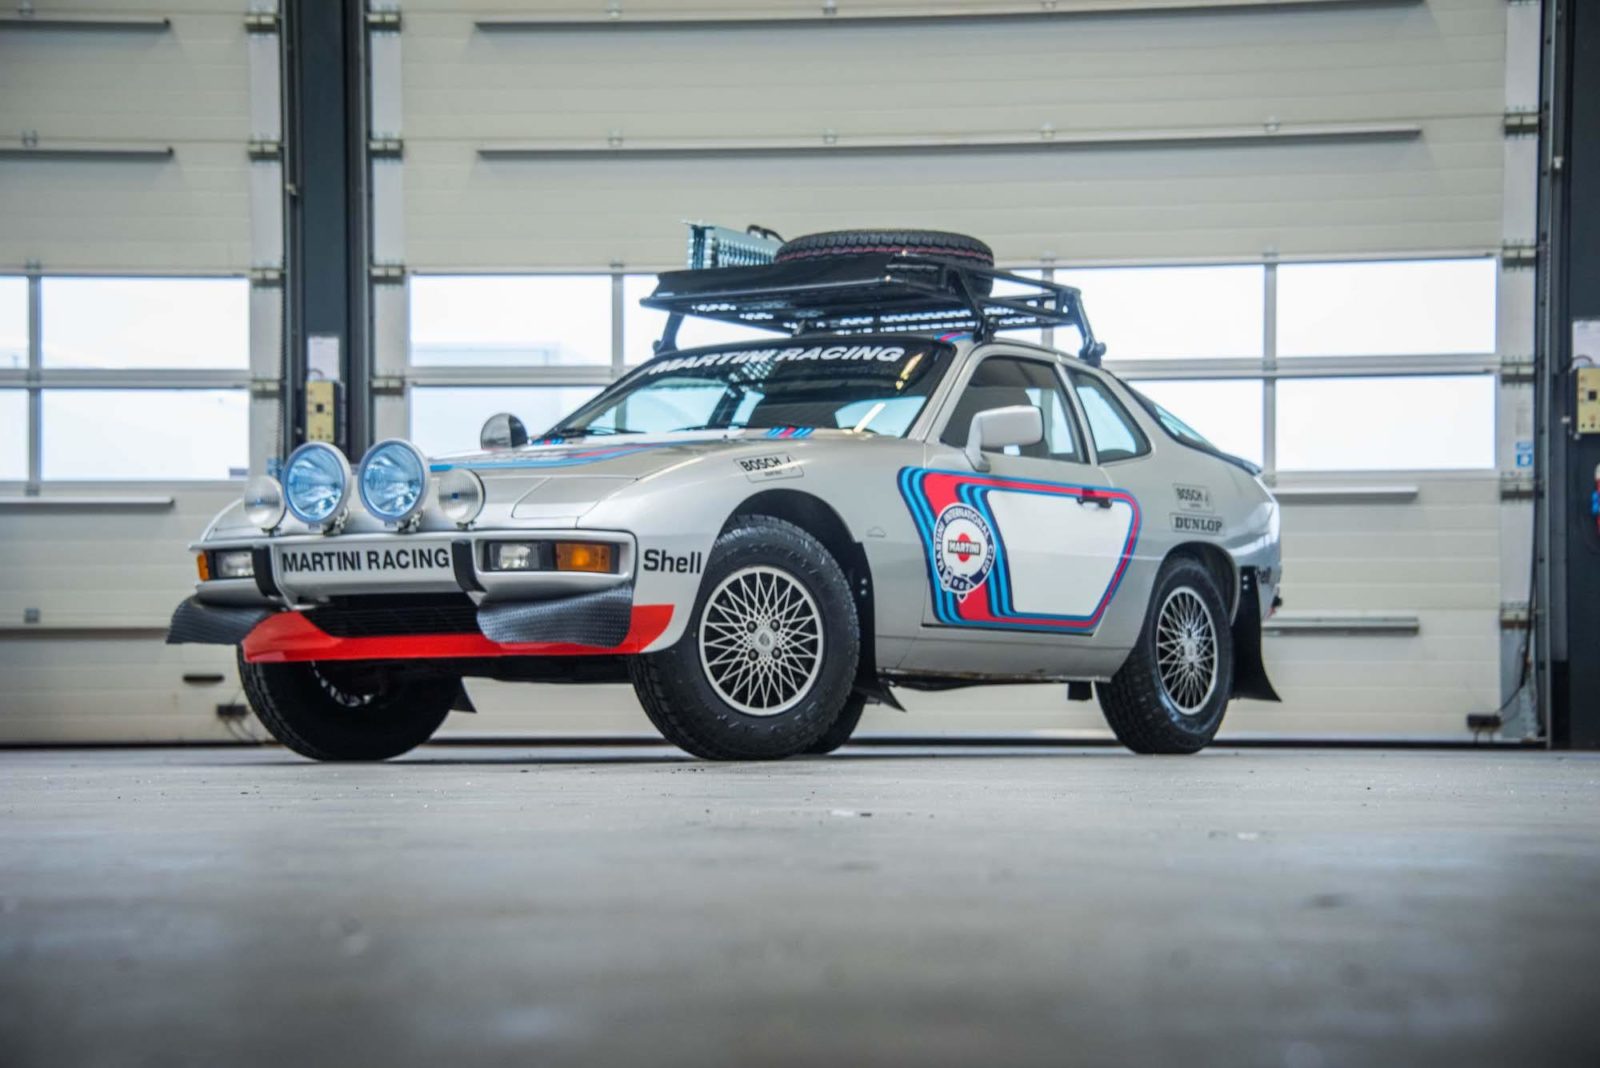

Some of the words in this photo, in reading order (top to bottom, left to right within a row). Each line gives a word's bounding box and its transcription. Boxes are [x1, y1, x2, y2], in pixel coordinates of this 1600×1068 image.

[648, 349, 777, 375] MARTINI
[774, 346, 905, 362] RACING
[740, 456, 782, 472] BOSCH
[1175, 516, 1223, 532] DUNLOP
[949, 540, 980, 555] MARTINI
[281, 551, 362, 573] MARTINI
[367, 548, 450, 570] RACING
[643, 549, 702, 574] Shell
